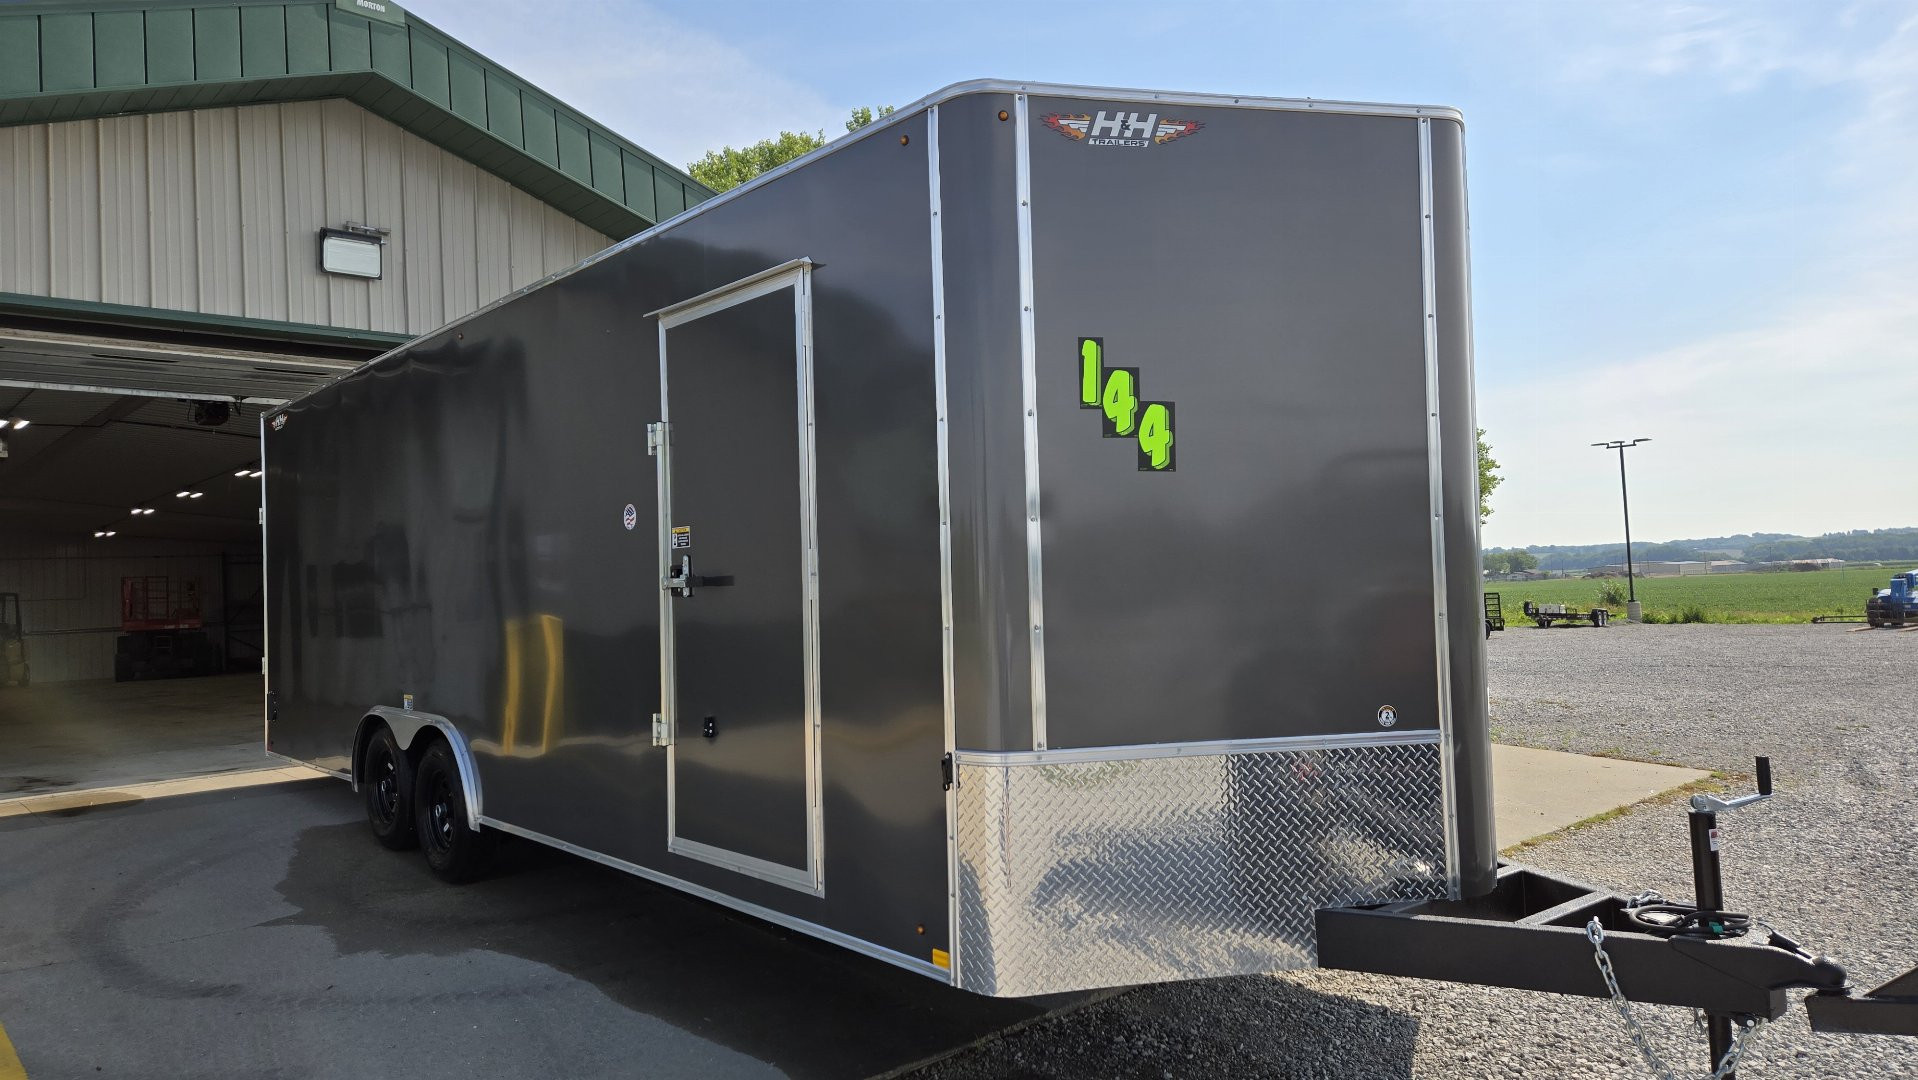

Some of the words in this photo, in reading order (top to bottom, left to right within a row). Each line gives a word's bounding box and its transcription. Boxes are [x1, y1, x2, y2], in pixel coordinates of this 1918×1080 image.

[356, 0, 385, 12] MORTON
[1091, 110, 1157, 138] H&H
[1091, 138, 1147, 147] TRAILERS
[1081, 339, 1174, 470] 144
